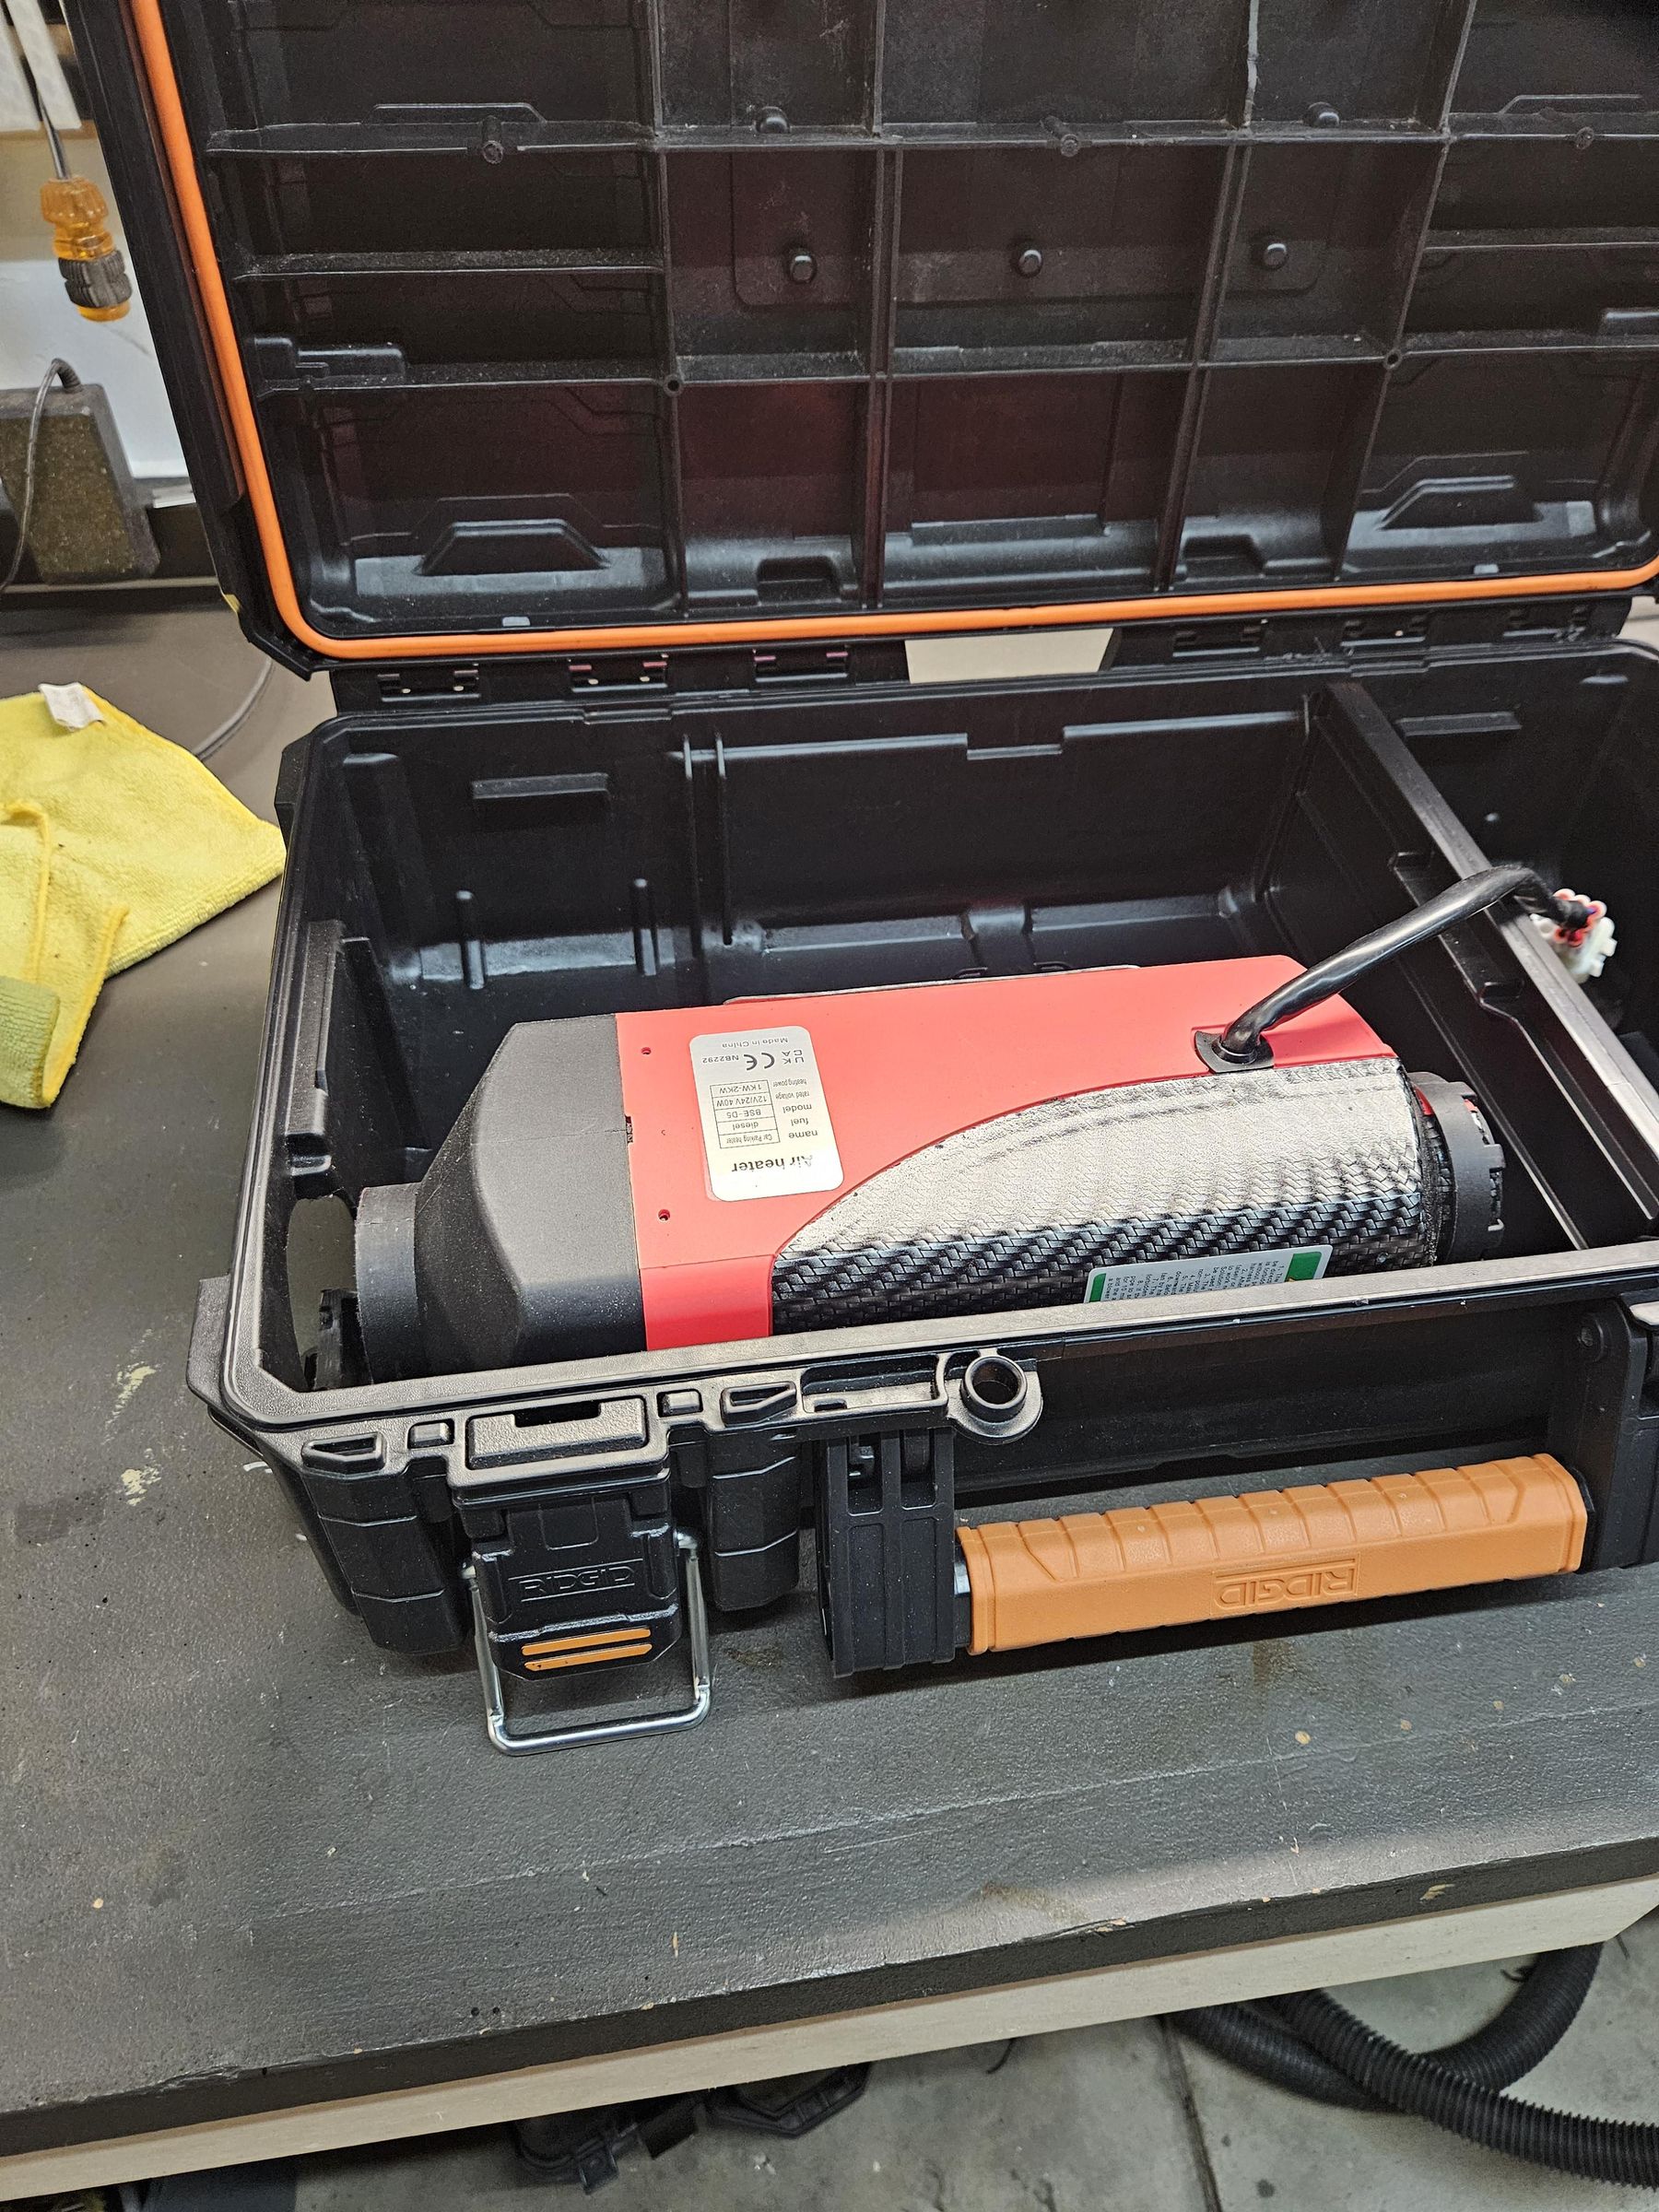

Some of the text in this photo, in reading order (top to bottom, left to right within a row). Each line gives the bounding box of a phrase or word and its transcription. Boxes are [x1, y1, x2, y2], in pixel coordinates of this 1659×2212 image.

[702, 1054, 739, 1063] NB2292
[735, 1096, 767, 1104] 12V/24V
[782, 1104, 812, 1113] model
[726, 1109, 761, 1118] BSE-D5
[732, 1122, 759, 1130] diesel
[791, 1118, 808, 1126] fuel
[744, 1135, 761, 1143] Parking
[788, 1130, 818, 1139] name
[732, 1156, 812, 1172] Air heater
[519, 1566, 635, 1594] RIDGID
[1218, 1566, 1355, 1608] RIDGID
